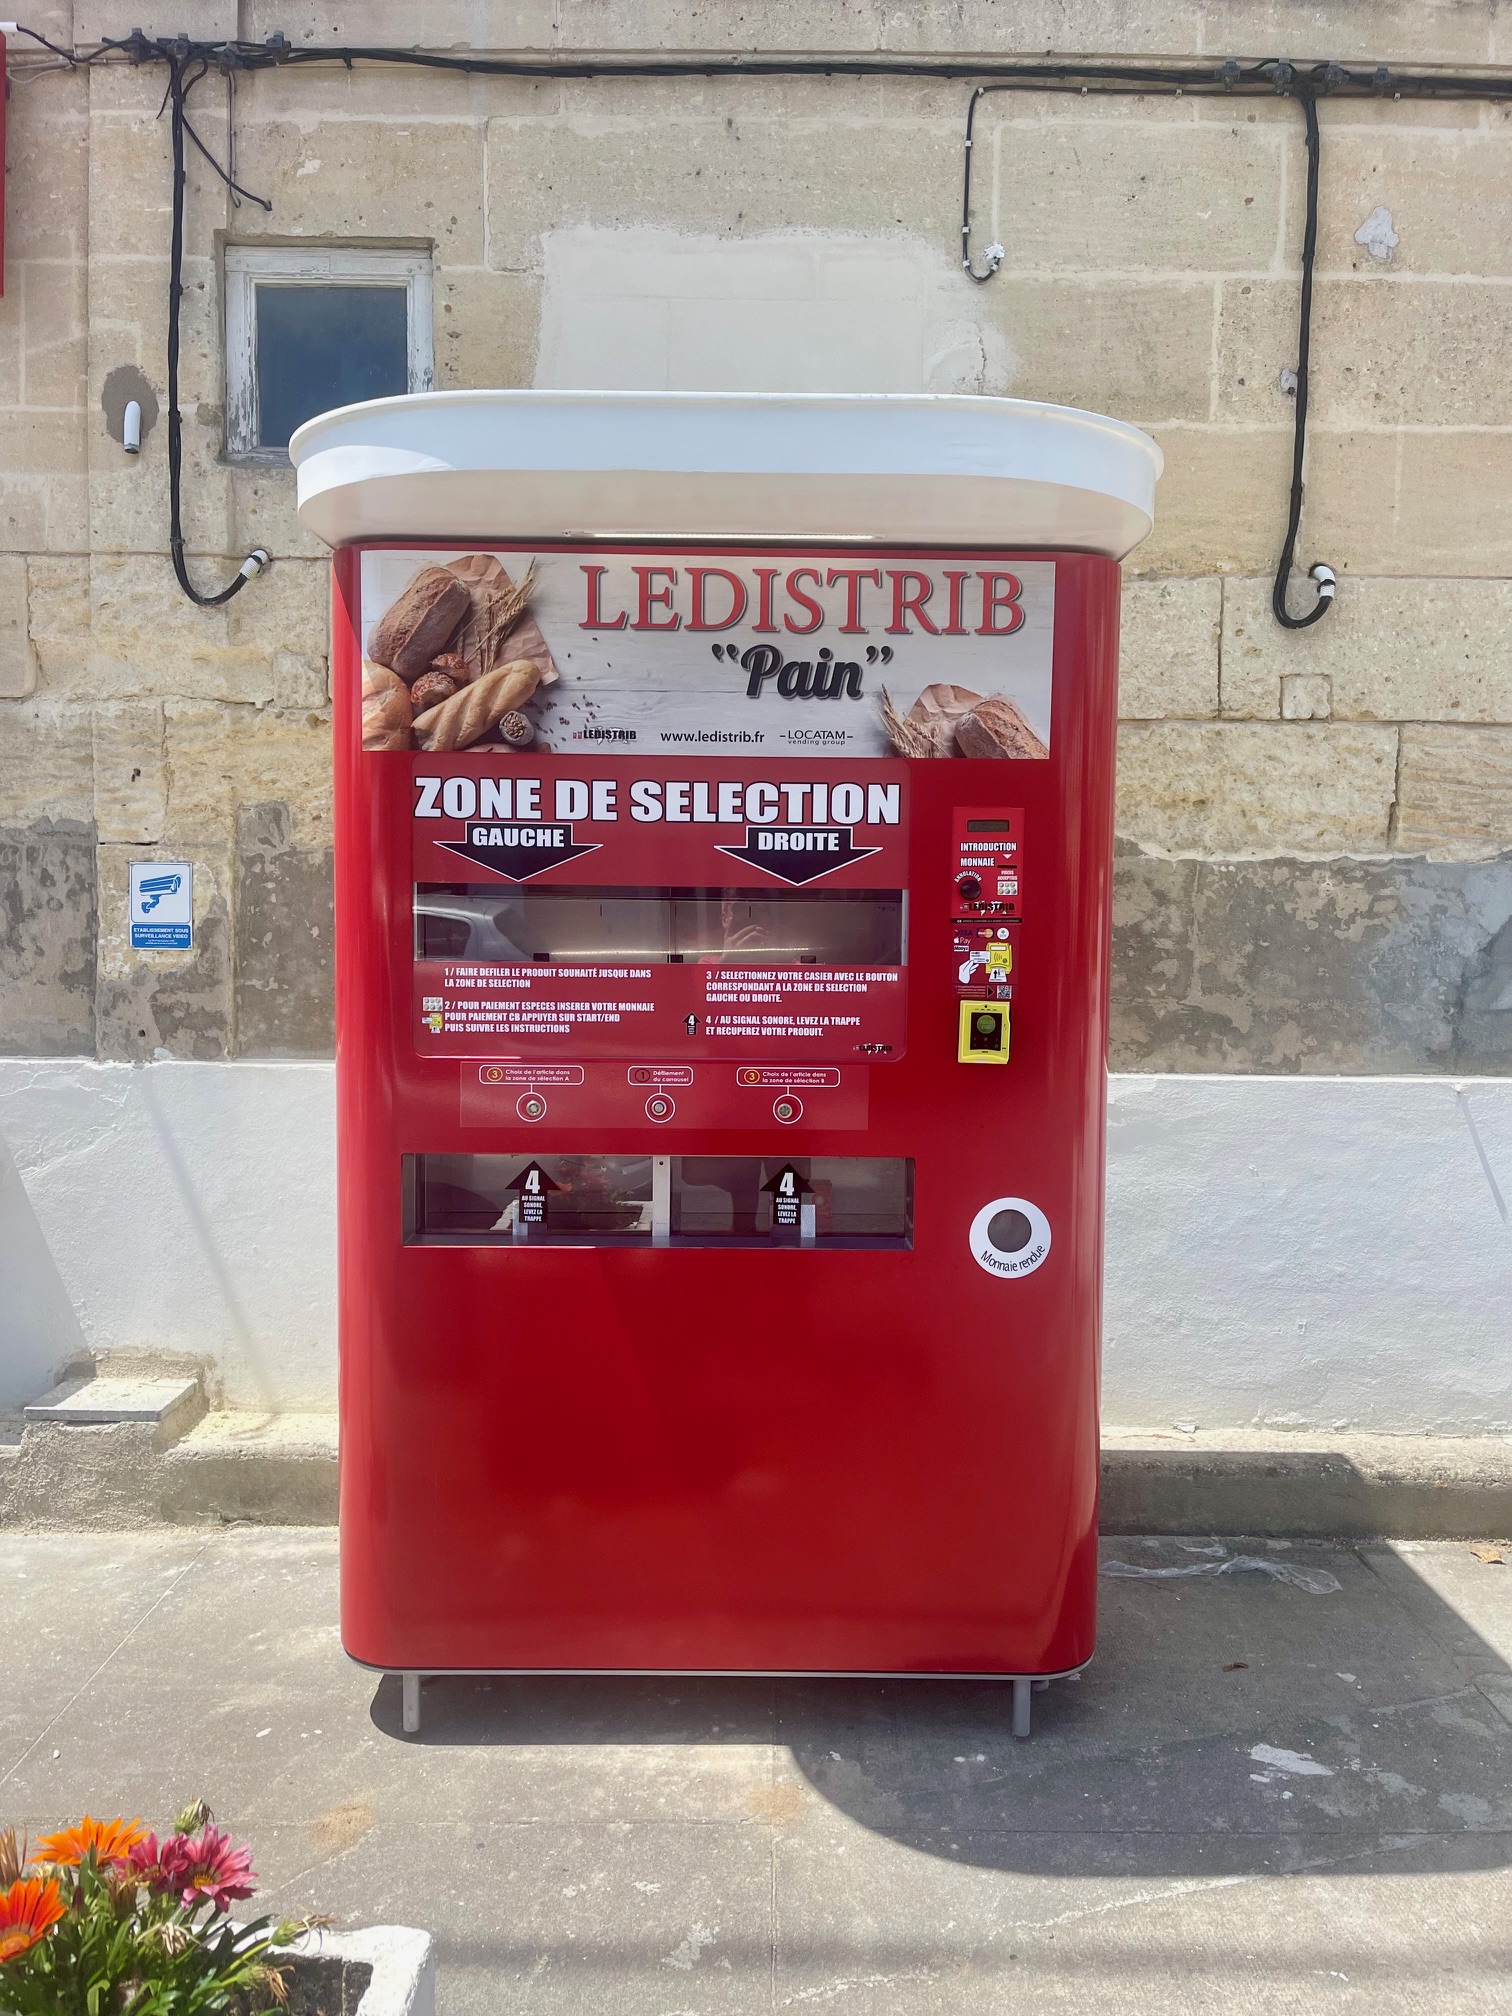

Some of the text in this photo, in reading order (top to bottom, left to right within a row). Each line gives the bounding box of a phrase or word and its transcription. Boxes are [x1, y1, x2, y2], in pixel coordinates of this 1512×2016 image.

[578, 565, 1027, 636] LEDISTRIB
[584, 730, 636, 740] LEDISTRIB
[660, 730, 765, 743] www.ledistrib.fr
[414, 778, 900, 825] ZONE DE SELECTION
[472, 827, 565, 848] GAUCHE
[757, 832, 840, 851] DROITE
[960, 842, 1016, 851] INTRODUCTION
[960, 858, 994, 866] MONNAIE
[444, 968, 449, 976] 1
[456, 968, 479, 976] FAIRE
[480, 968, 510, 977] DEFILER
[512, 968, 520, 977] LE
[522, 969, 557, 977] PRODUIT
[599, 969, 628, 978] JUSQUE
[630, 969, 651, 978] DANS
[706, 972, 712, 980] 3
[721, 972, 776, 980] SELECTIONNEZ
[778, 972, 803, 981] VOTRE
[804, 972, 832, 981] CASIER
[834, 972, 854, 981] AVEC
[855, 973, 864, 981] LE
[866, 973, 898, 982] BOUTON
[456, 979, 475, 988] ZONE
[477, 979, 487, 988] DE
[489, 979, 530, 988] SELECTION
[706, 982, 774, 991] CORRESPONDANT
[782, 983, 792, 991] LA
[793, 983, 812, 992] ZONE
[815, 983, 824, 992] DE
[826, 983, 867, 992] SELECTION
[706, 993, 782, 1002] GAUCHE OU DROITE.
[444, 1001, 450, 1009] 2
[458, 1001, 479, 1010] POUR
[481, 1002, 520, 1010] PAIEMENT
[522, 1002, 556, 1011] ESPECES
[557, 1002, 590, 1011] INSERER
[591, 1002, 617, 1011] VOTRE
[618, 1003, 654, 1012] MONNAIE
[445, 1013, 620, 1022] POUR PAIEMENT CB APPUYER SUR START/END
[732, 1016, 760, 1024] SIGNAL
[796, 1017, 818, 1025] LEVEZ
[820, 1017, 829, 1025] LA
[830, 1017, 860, 1026] TRAPPE
[445, 1024, 570, 1033] PUIS SUIVRE LES INSTRUCTIONS
[716, 1028, 760, 1036] RECUPEREZ
[761, 1028, 786, 1036] VOTRE
[788, 1028, 823, 1037] PRODUIT.
[749, 1072, 755, 1080] 3
[525, 1170, 540, 1193] 4
[780, 1172, 794, 1196] 4
[981, 1245, 1045, 1272] Monnaie rendue
